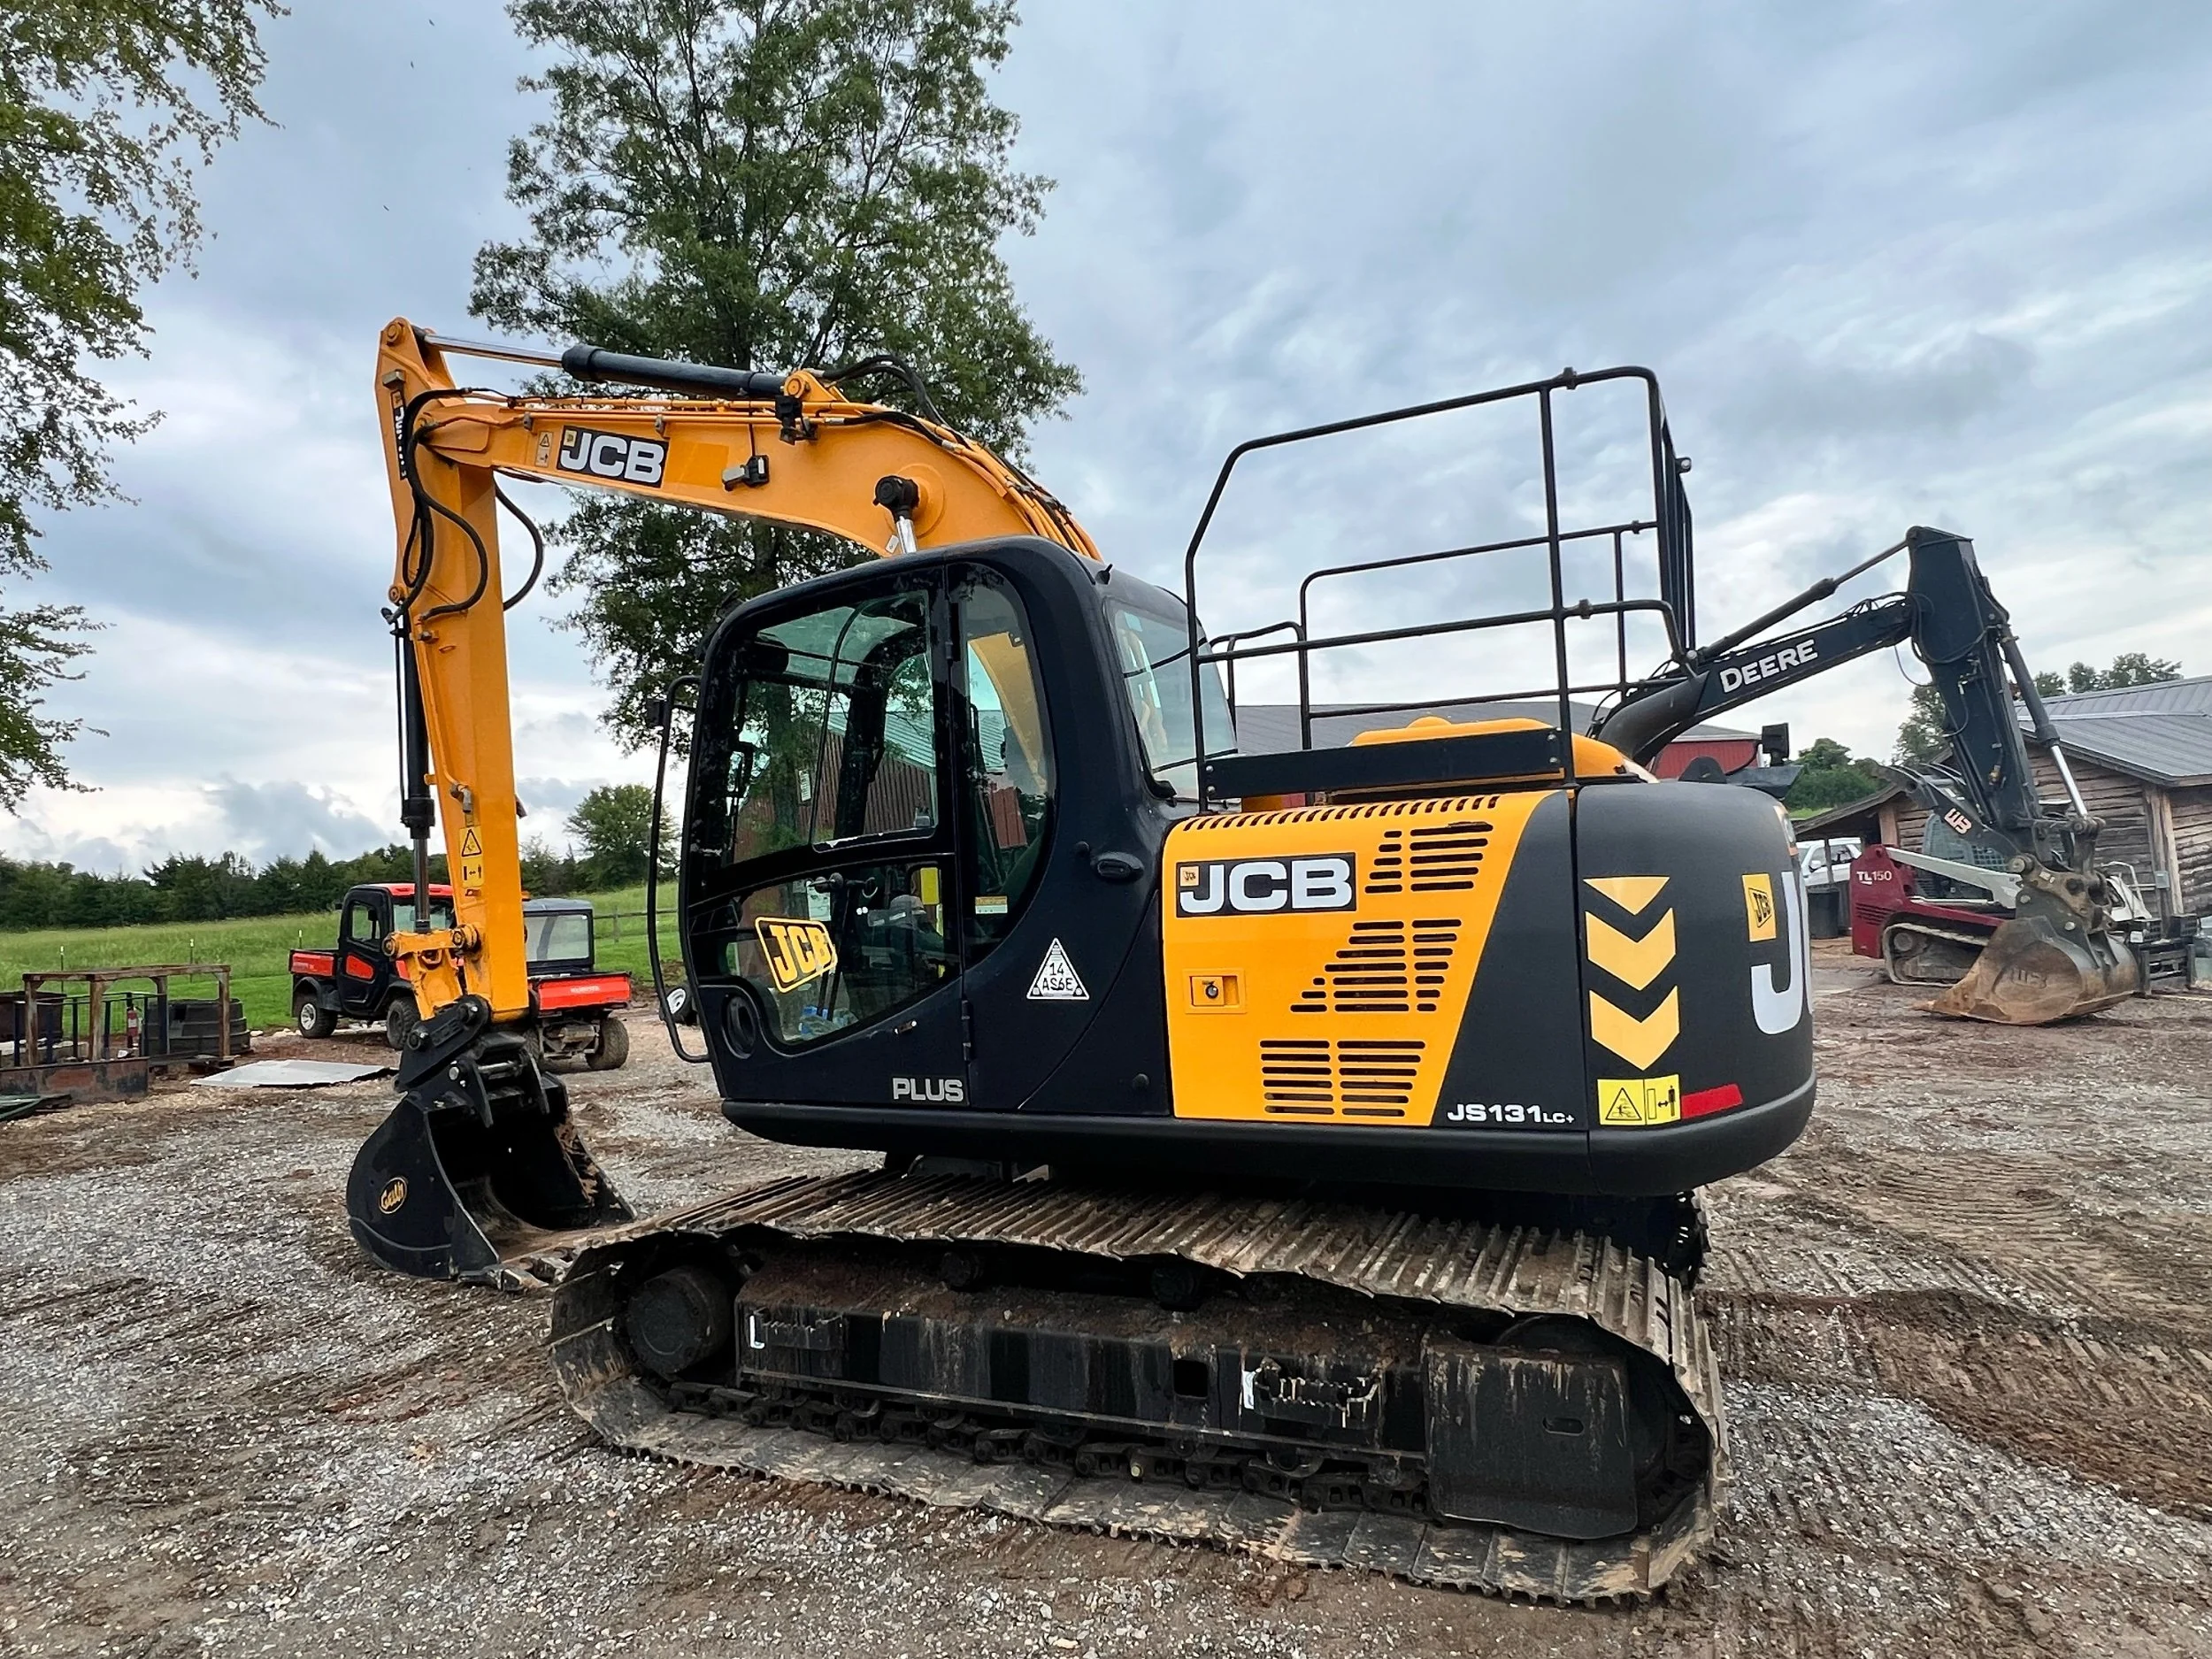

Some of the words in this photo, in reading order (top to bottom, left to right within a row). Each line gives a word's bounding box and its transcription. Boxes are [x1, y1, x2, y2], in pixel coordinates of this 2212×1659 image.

[560, 432, 664, 483] JCB
[1719, 639, 1818, 693] DEERE
[1180, 858, 1353, 914] JCB
[1856, 871, 1893, 884] TL150
[769, 925, 832, 983] JCB
[1049, 963, 1064, 976] 14
[893, 1078, 964, 1102] PLUS
